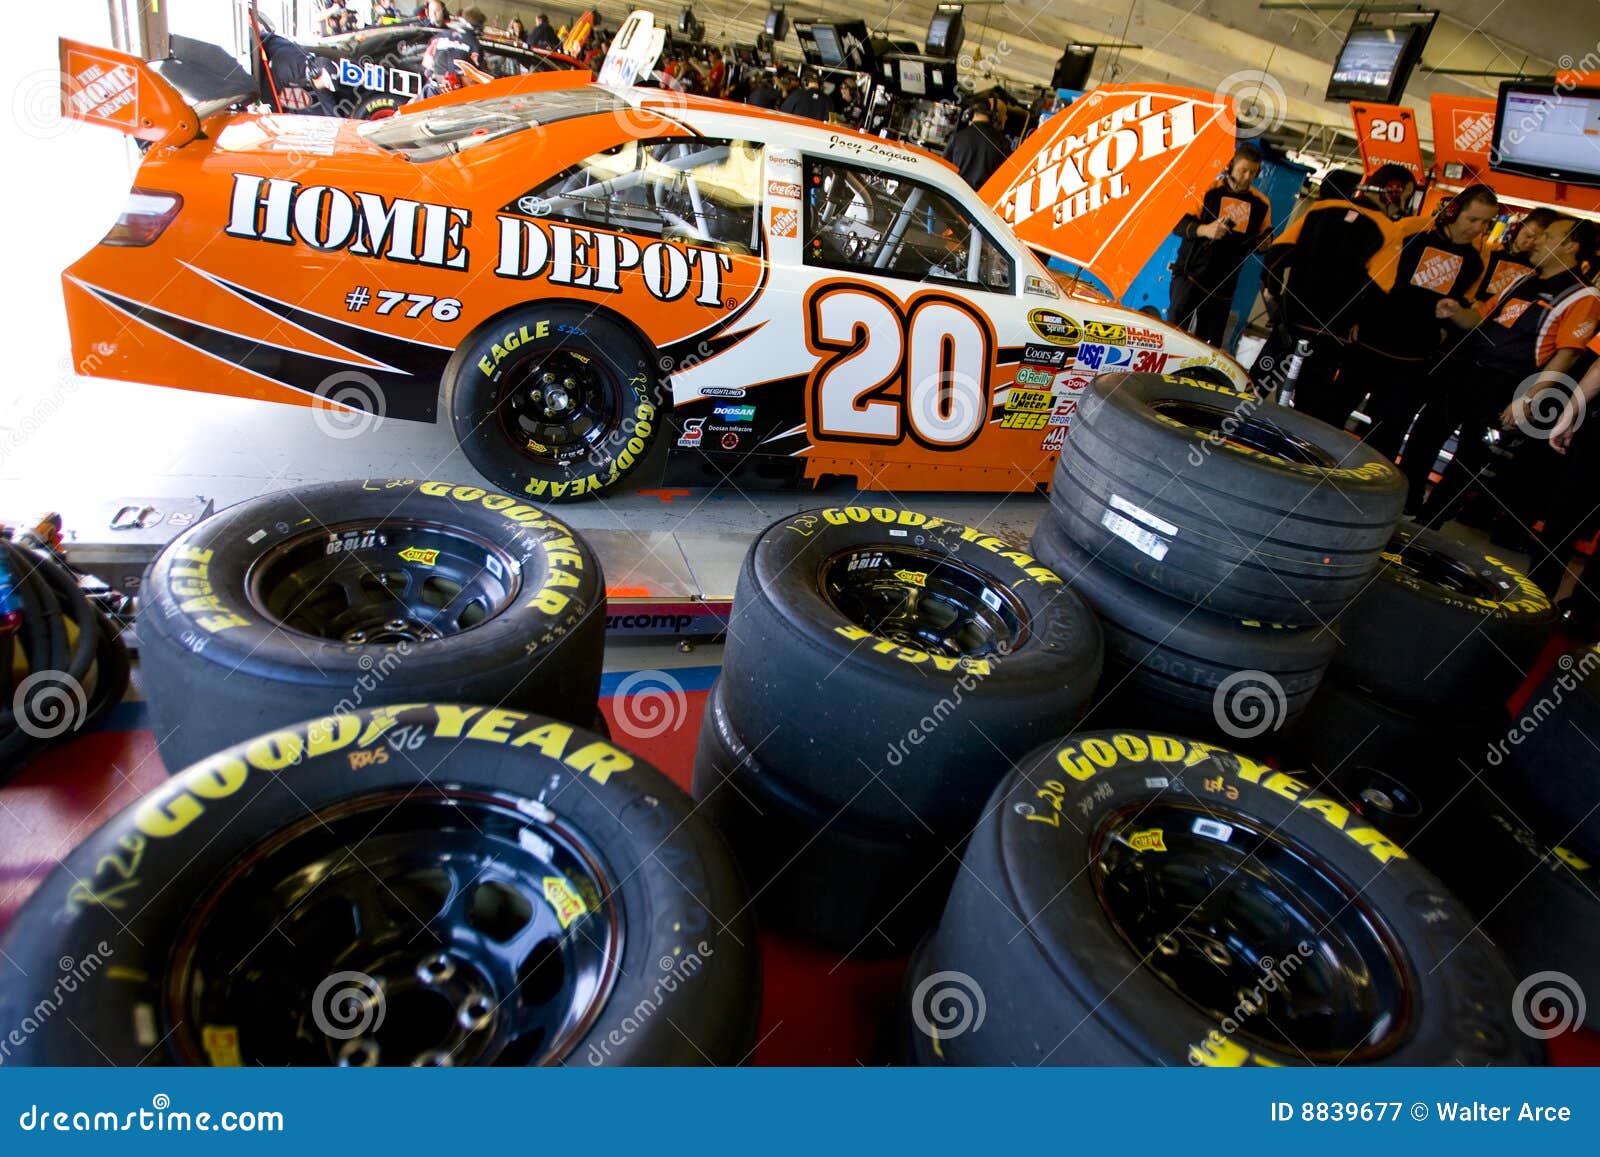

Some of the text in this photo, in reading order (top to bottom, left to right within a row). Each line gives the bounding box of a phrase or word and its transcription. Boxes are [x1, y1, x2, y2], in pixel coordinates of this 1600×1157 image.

[331, 58, 385, 91] bil
[71, 64, 136, 114] HOME
[366, 98, 395, 112] EAGLE
[1030, 95, 1152, 176] DEPOT
[1371, 119, 1405, 143] 20
[1455, 112, 1495, 151] HOME
[829, 135, 862, 155] Joey
[1000, 99, 1196, 229] HOME
[1052, 172, 1130, 230] THE
[225, 172, 732, 310] HOME DEPOT
[1046, 324, 1066, 334] Sprint
[1126, 327, 1163, 348] Holley
[477, 319, 550, 378] EAGLE
[1025, 346, 1052, 359] Coors
[1077, 343, 1104, 369] USG
[803, 277, 998, 452] 20
[1132, 351, 1168, 374] 3M
[1016, 367, 1052, 386] O'Reilly
[1161, 374, 1256, 401] EAGLE
[701, 387, 742, 396] FREIGHTLINER
[1020, 392, 1045, 401] Auto
[713, 406, 755, 417] DOOSAN
[1016, 402, 1047, 410] Meter
[709, 425, 729, 433] Doosan
[1001, 413, 1050, 430] JEGS
[1044, 427, 1064, 443] MA
[419, 481, 584, 617] GOODYEAR
[822, 506, 1064, 584] GOODYEAR
[605, 613, 692, 632] ercomp
[834, 625, 991, 676] EAGLE
[134, 703, 636, 838] GOODYEAR
[1057, 733, 1410, 864] GOODYEAR
